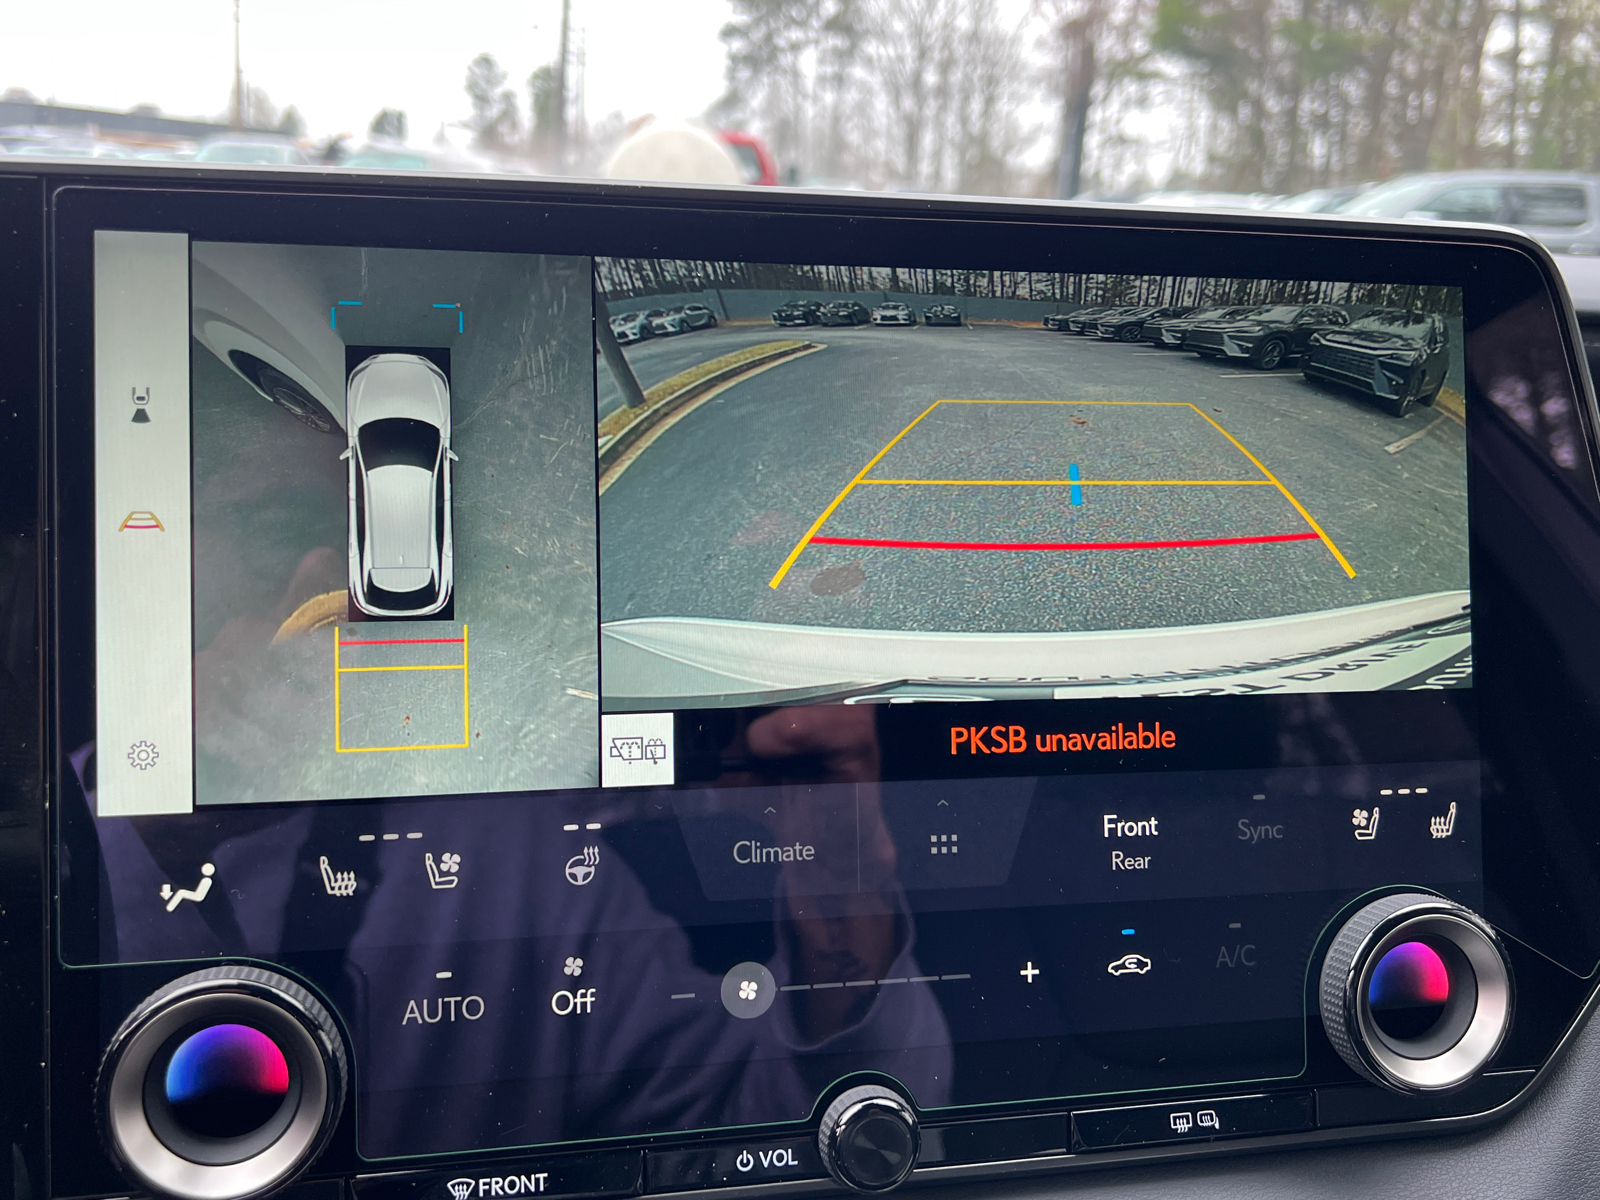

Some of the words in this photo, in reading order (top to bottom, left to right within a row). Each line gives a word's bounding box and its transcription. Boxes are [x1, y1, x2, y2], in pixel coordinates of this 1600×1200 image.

[950, 725, 1028, 755] PKSB
[1035, 721, 1176, 753] unavailable
[1103, 814, 1159, 838] Front
[1237, 818, 1284, 845] Sync
[733, 840, 815, 864] Climate
[1111, 850, 1152, 871] Rear
[1215, 944, 1256, 969] A/C
[402, 995, 485, 1026] AUTO
[551, 988, 596, 1016] Off
[758, 1148, 799, 1168] VOL
[478, 1172, 548, 1198] FRONT
